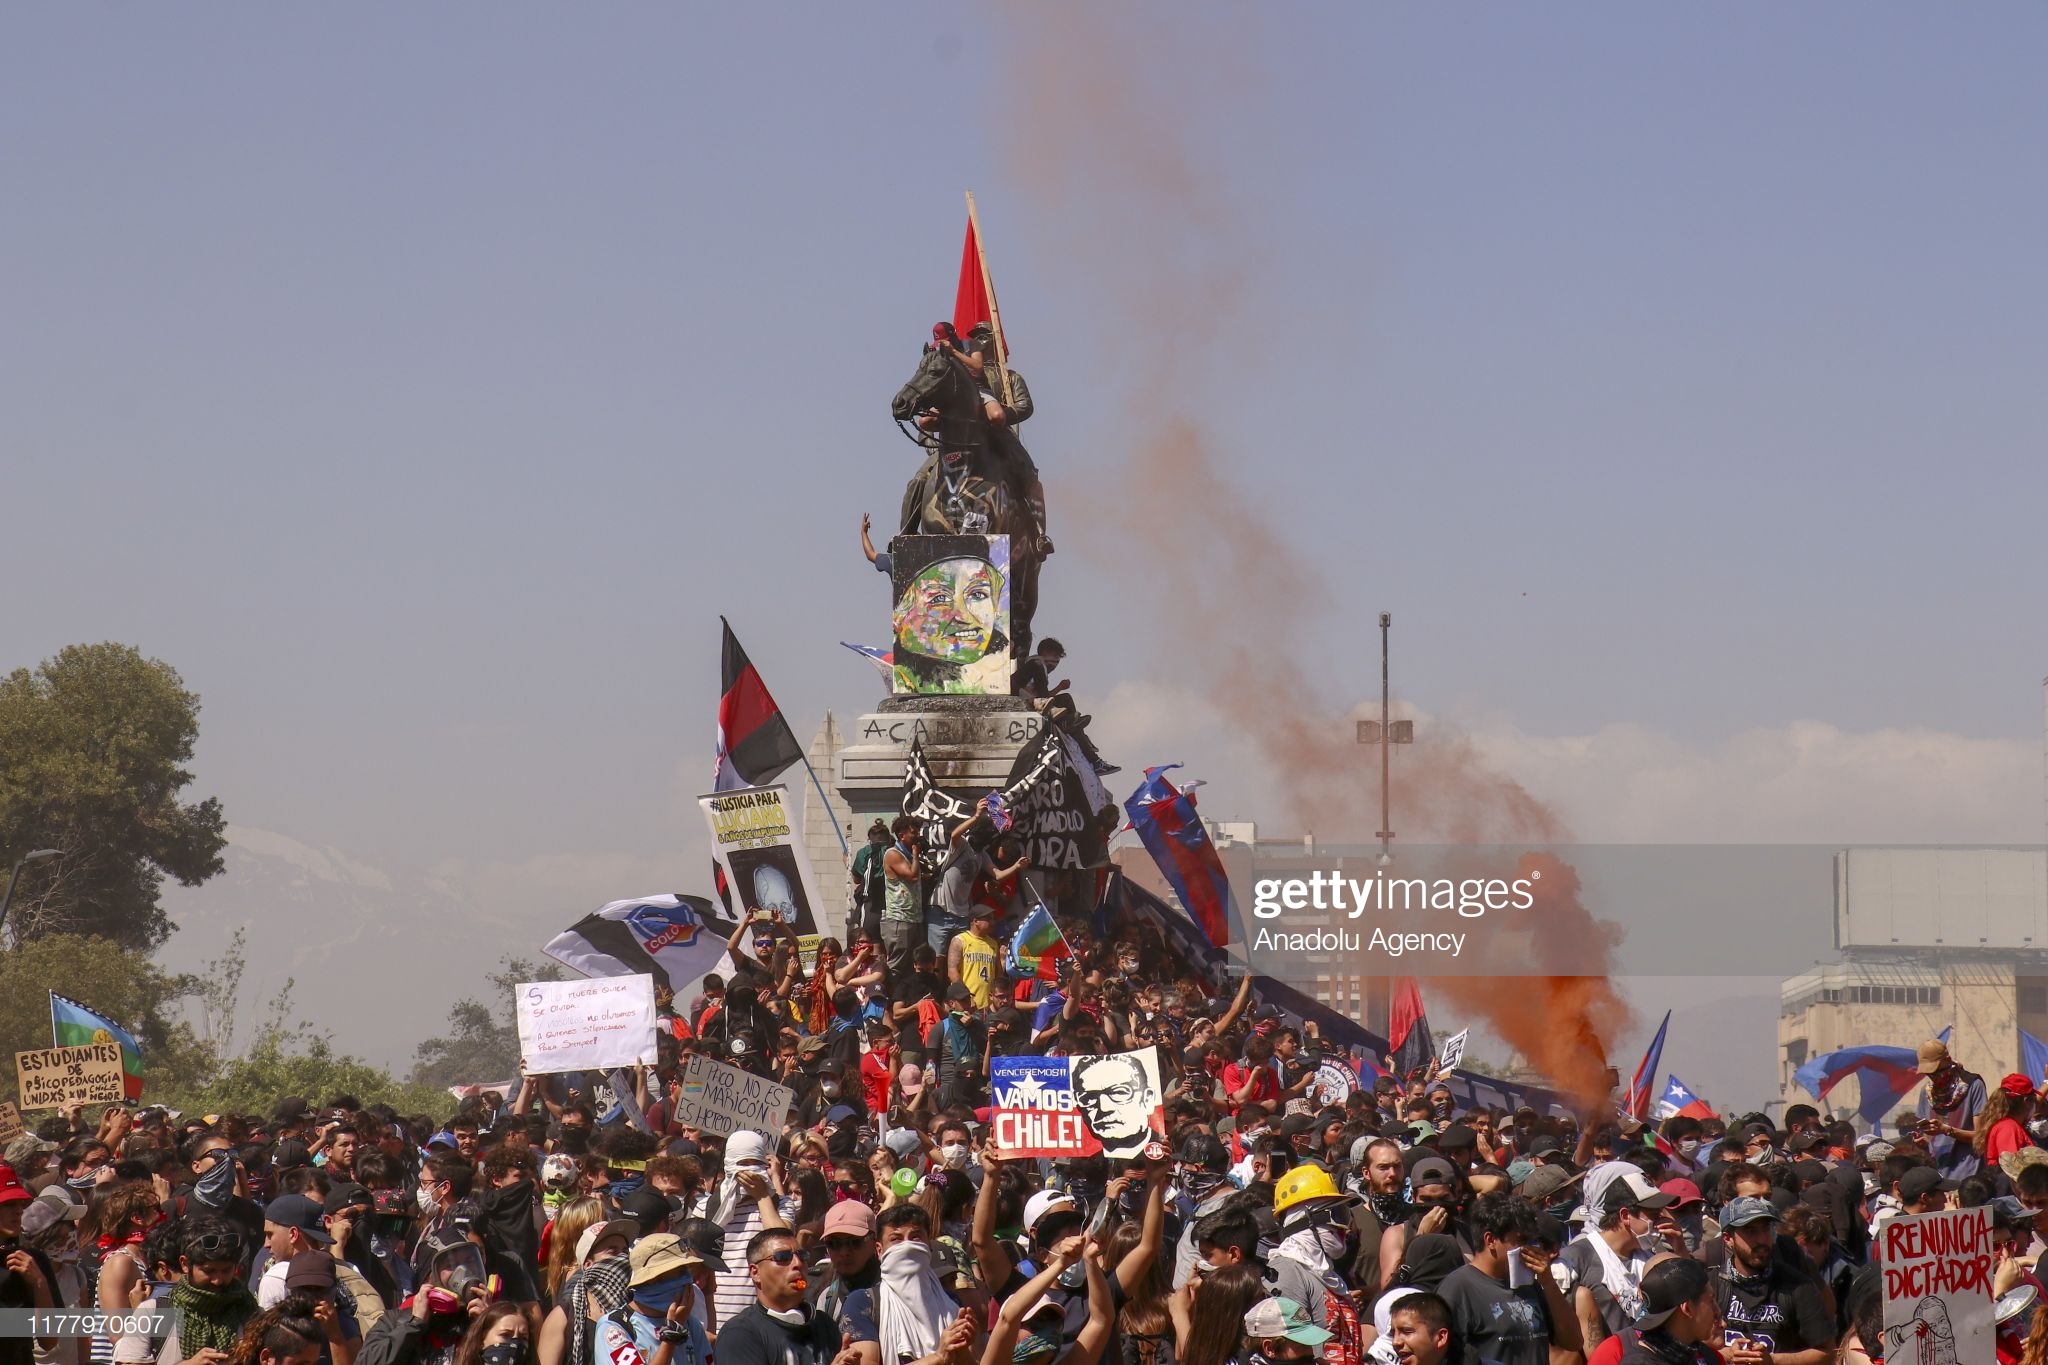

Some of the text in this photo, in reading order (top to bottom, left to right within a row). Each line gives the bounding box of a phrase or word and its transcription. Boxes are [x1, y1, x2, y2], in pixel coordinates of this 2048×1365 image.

[755, 791, 781, 807] PARA
[712, 804, 786, 834] LUCIANO
[980, 966, 989, 982] 4
[68, 1064, 83, 1076] DE
[1341, 1067, 1356, 1085] CHILE
[24, 1089, 66, 1106] UNIDXS
[743, 1077, 760, 1099] NO
[764, 1085, 784, 1107] ES
[994, 1087, 1075, 1112] VAMOS
[678, 1097, 695, 1121] ES
[1887, 1209, 1994, 1263] RENUNCIA
[1884, 1254, 1994, 1304] DICTADOR
